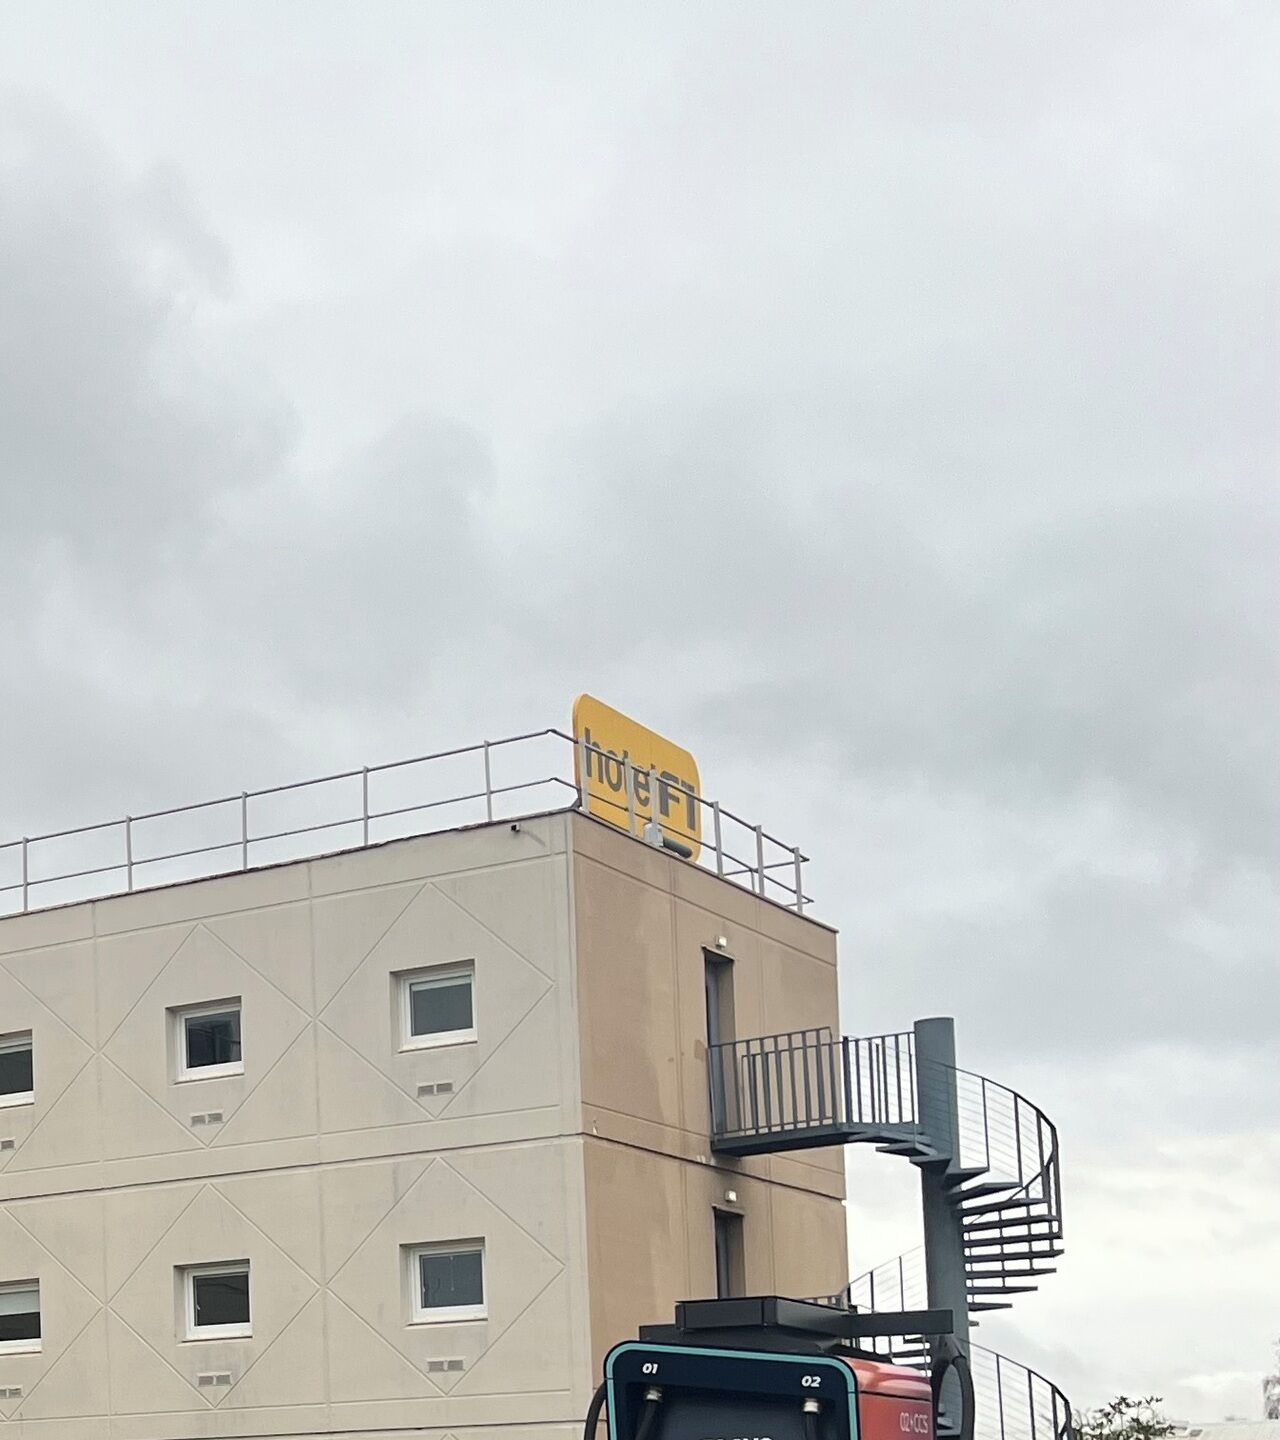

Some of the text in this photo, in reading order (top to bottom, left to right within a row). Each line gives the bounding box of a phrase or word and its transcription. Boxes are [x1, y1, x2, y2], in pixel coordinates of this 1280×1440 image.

[584, 726, 697, 832] hoeF1
[642, 1363, 658, 1374] 01
[801, 1376, 821, 1387] 02
